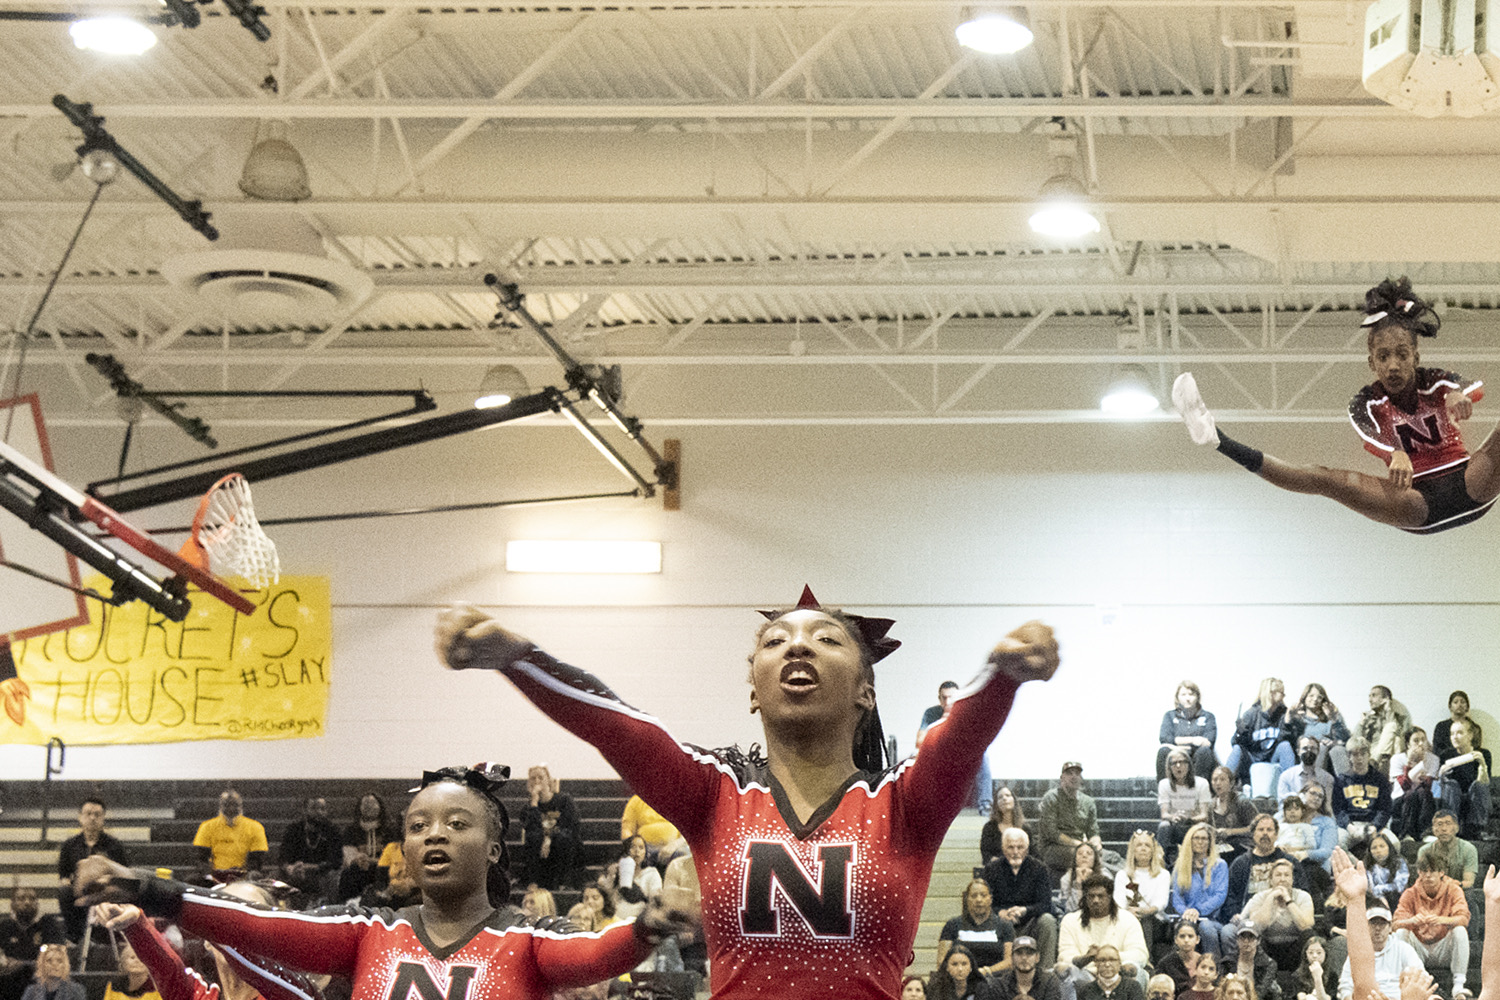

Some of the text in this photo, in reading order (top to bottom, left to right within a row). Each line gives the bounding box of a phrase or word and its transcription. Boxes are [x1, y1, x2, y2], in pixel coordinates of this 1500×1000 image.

[1393, 412, 1443, 453] N
[54, 667, 224, 727] HOUSE
[240, 656, 325, 688] #SLAY
[737, 838, 858, 940] N
